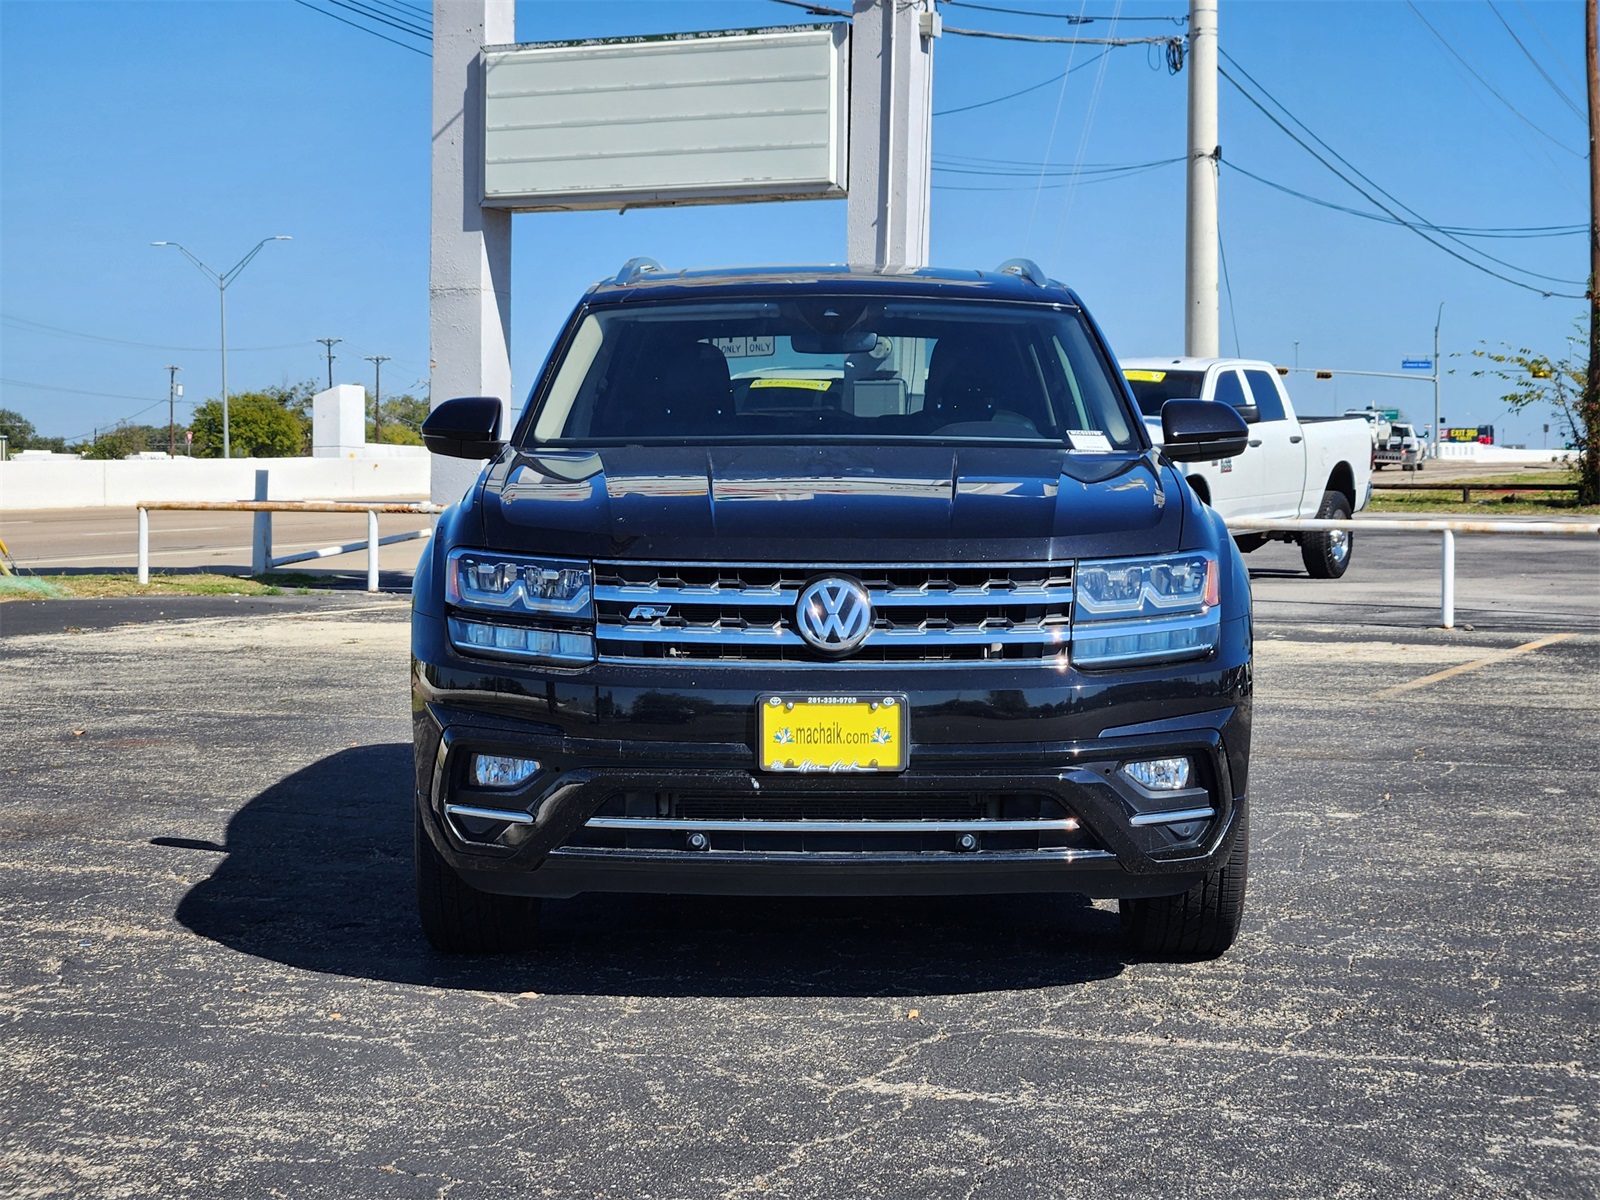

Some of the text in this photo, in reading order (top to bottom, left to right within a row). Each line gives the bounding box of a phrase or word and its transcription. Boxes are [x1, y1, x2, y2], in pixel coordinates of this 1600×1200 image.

[721, 344, 741, 354] ONLY
[749, 342, 771, 353] ONLY
[795, 722, 870, 745] machaik.com
